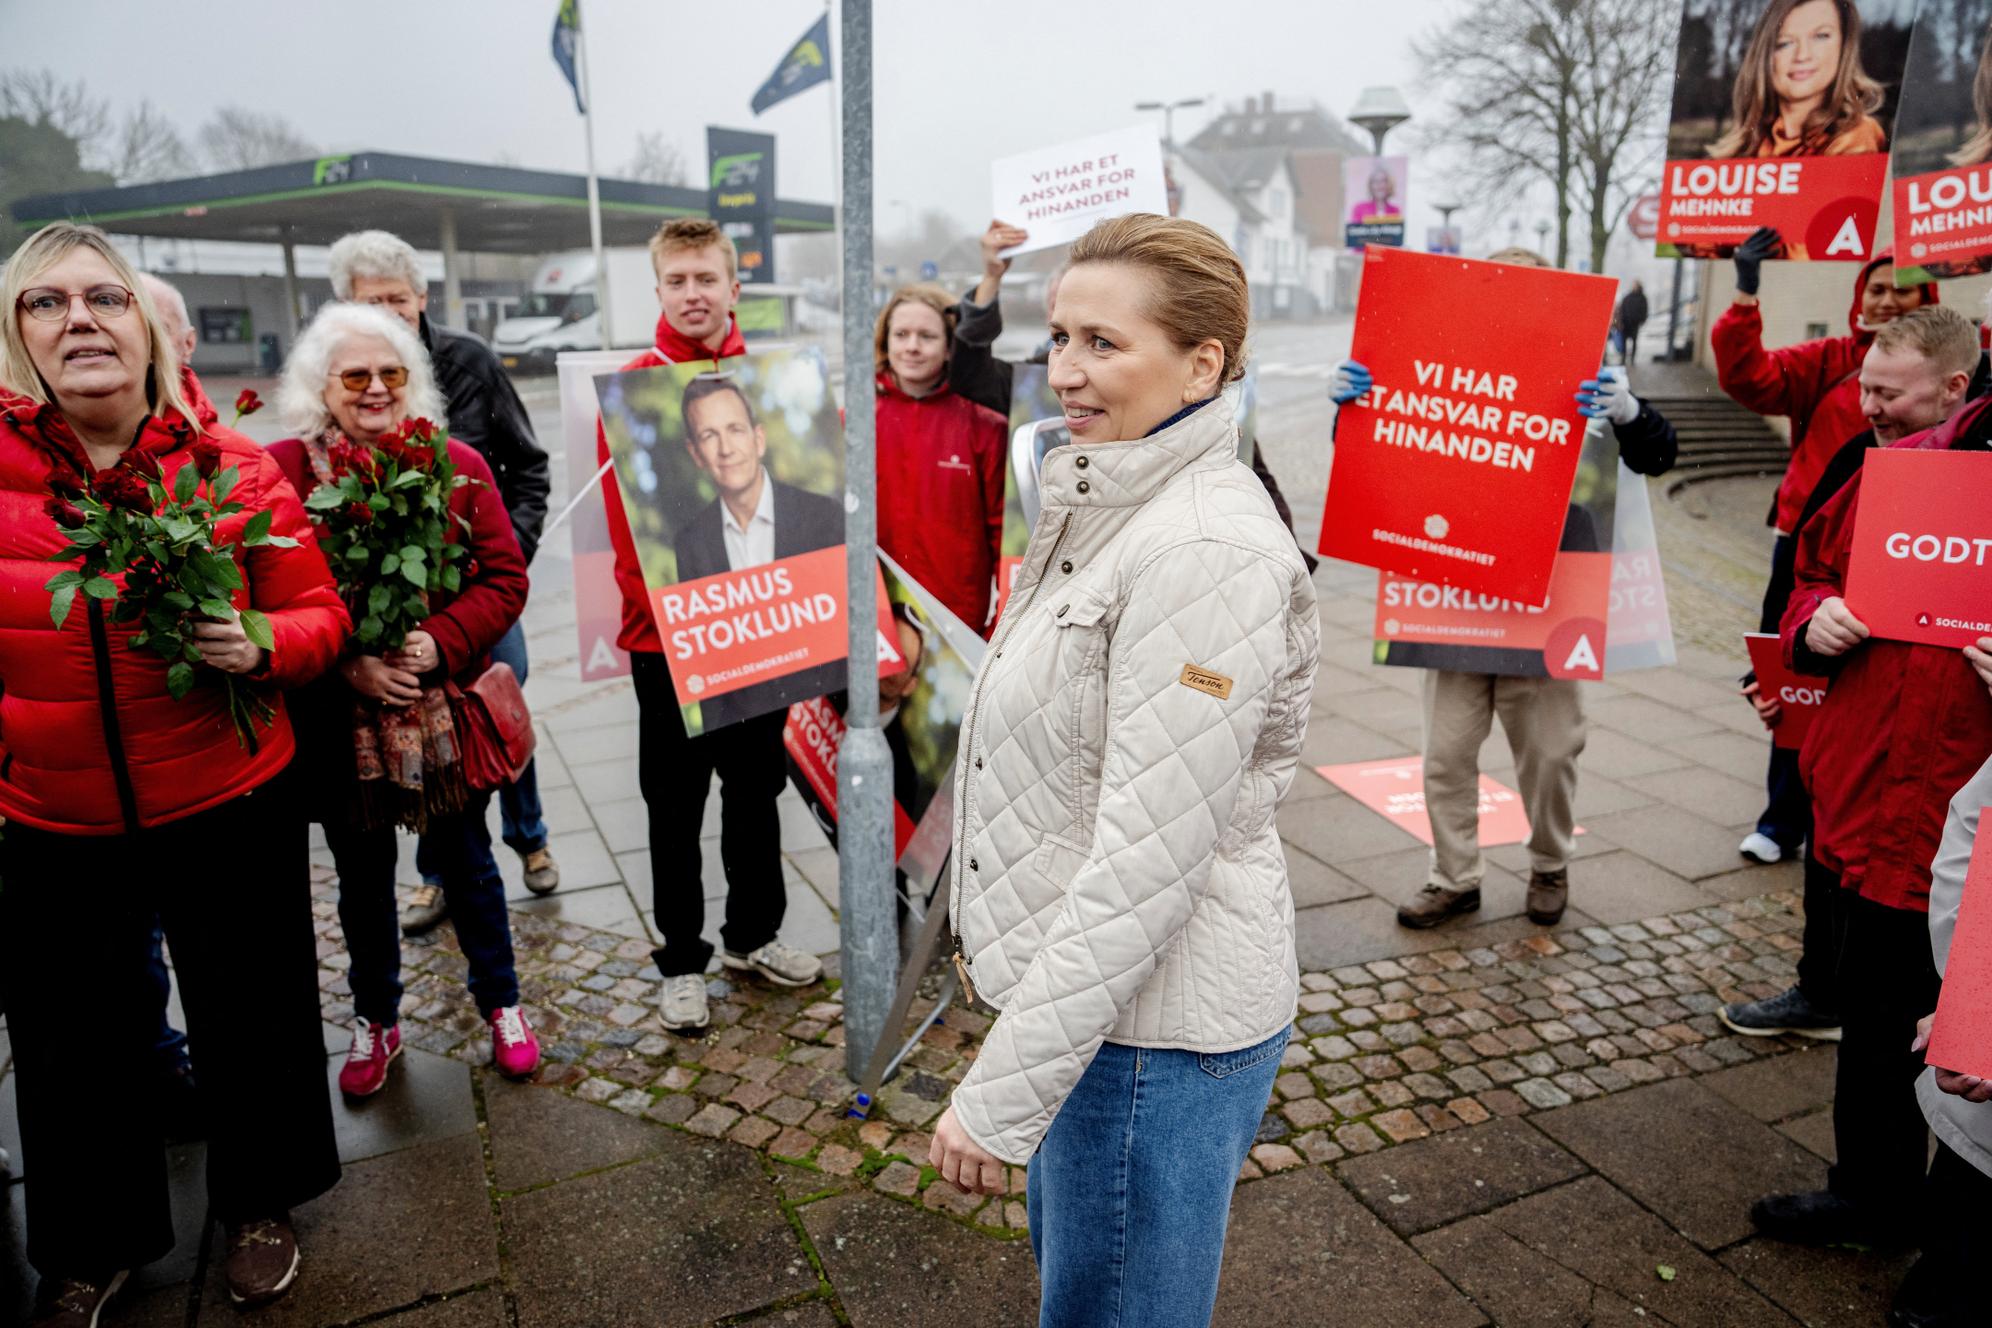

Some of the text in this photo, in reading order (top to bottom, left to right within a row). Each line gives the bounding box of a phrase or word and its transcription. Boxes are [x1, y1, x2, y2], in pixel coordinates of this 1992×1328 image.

[1018, 168, 1136, 205] ANSVAR FOR
[1031, 154, 1119, 184] VI HAR ET
[1671, 162, 1803, 196] LOUISE
[1027, 187, 1131, 220] HINANDEN
[1668, 197, 1754, 217] MEHNKE
[1908, 168, 1992, 214] LOU
[1825, 215, 1865, 256] A
[1414, 359, 1518, 401] VI HAR
[1385, 389, 1503, 433] ANSVAR
[1506, 410, 1571, 446] FOR
[1373, 417, 1536, 473] HINANDEN
[1372, 528, 1497, 567] SOCIALDEMOKRATIET
[1886, 532, 1992, 566] GODT
[662, 567, 794, 625] RASMUS
[671, 593, 837, 661] STOKLUND
[1402, 622, 1506, 638] SOCIALDEMOKRATIET
[1919, 615, 1992, 633] A SOCIALDE
[706, 647, 809, 687] SOCIALDEMOKRATIET
[1563, 633, 1599, 671] A
[1187, 671, 1224, 690] Tenson
